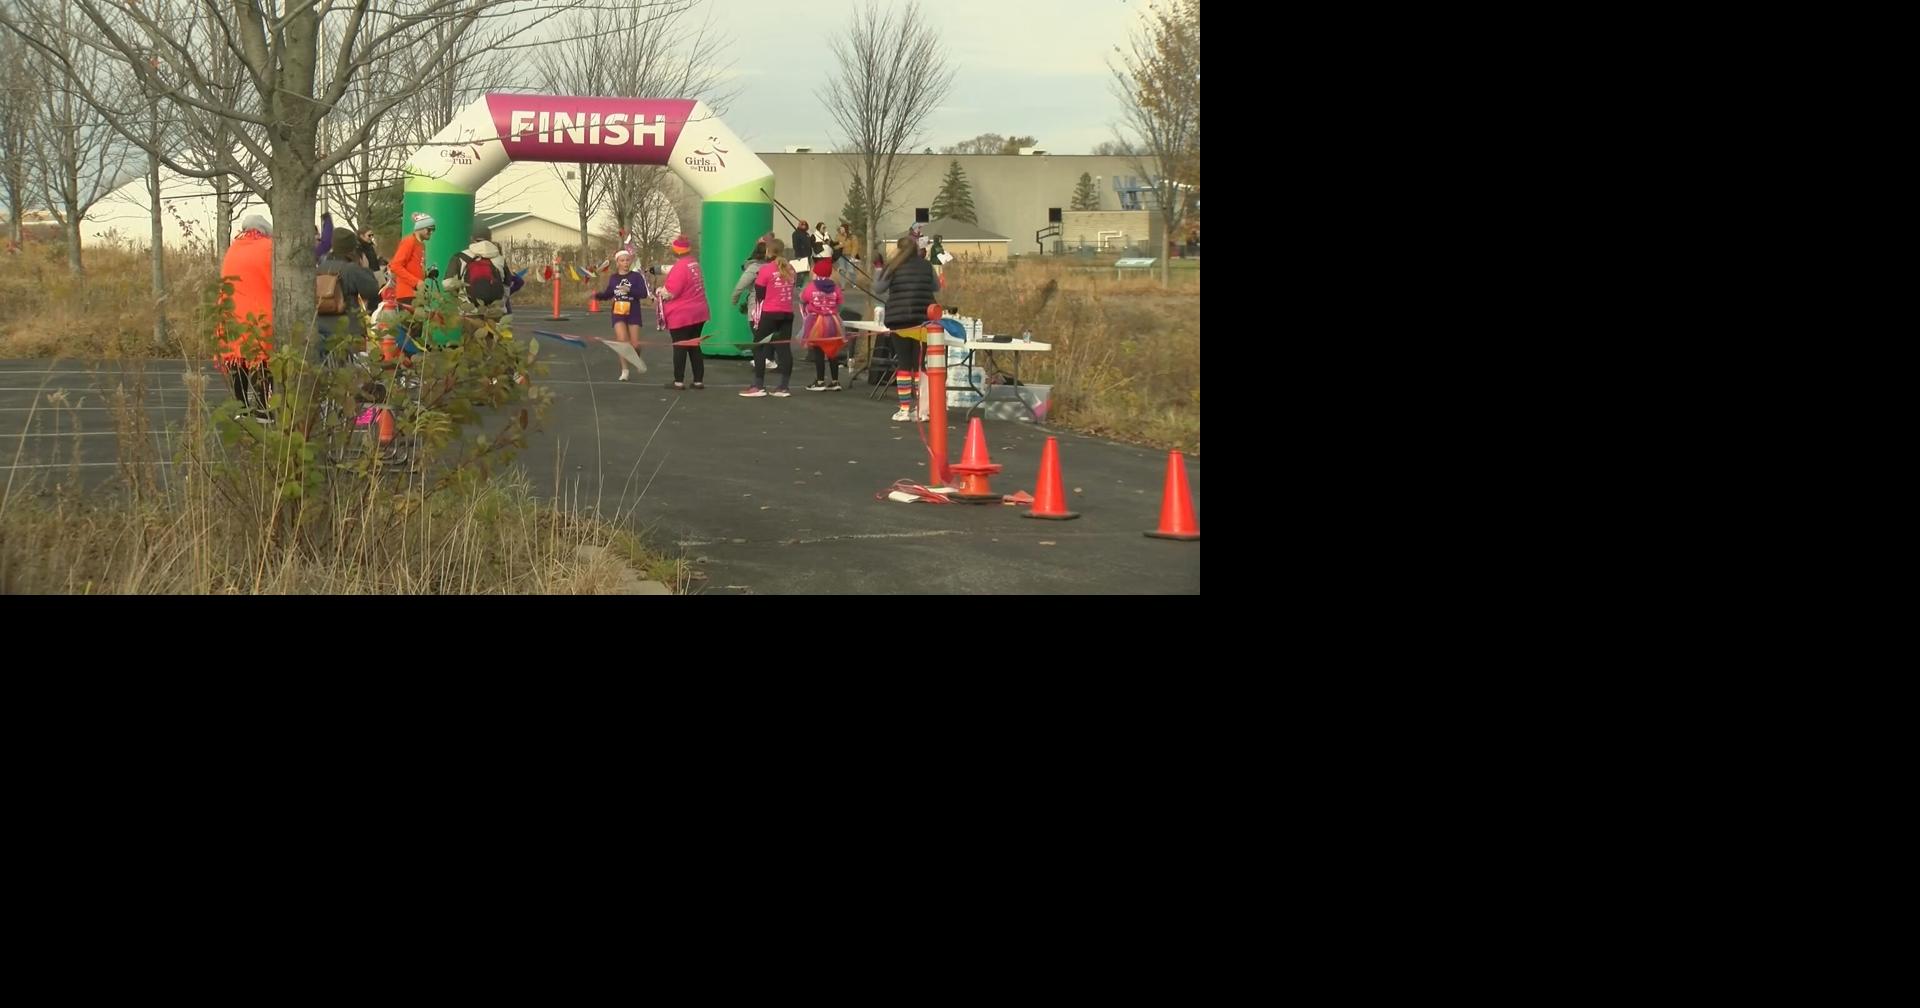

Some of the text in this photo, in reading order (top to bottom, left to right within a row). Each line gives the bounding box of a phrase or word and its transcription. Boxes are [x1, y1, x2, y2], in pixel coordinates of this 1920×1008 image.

[511, 110, 666, 147] FINISH
[684, 156, 711, 166] Girls
[697, 165, 717, 173] run
